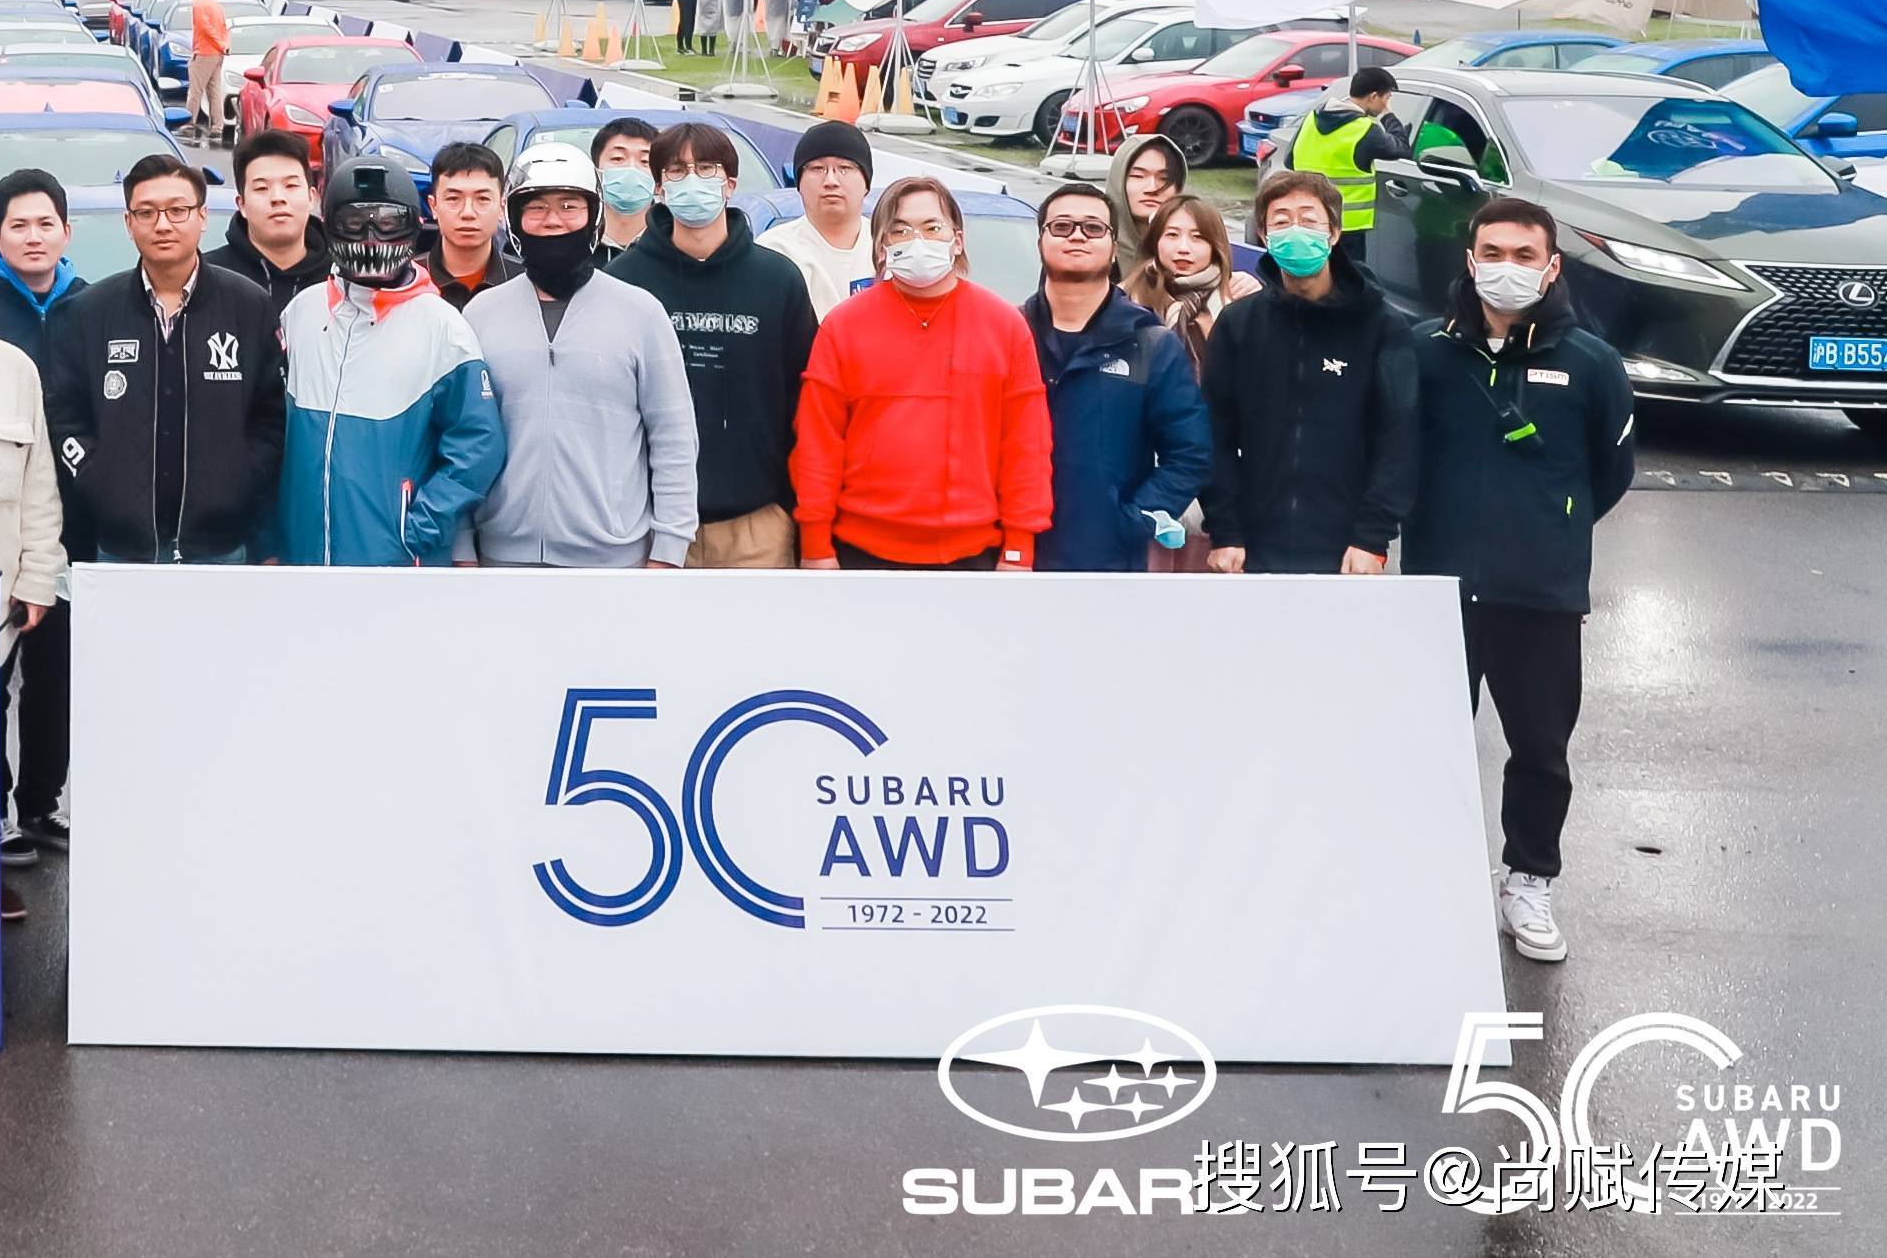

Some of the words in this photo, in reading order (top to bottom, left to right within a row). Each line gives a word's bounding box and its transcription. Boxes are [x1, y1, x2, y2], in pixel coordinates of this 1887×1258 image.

[815, 776, 1005, 806] SUBARU
[819, 815, 1011, 878] AWD
[848, 904, 904, 924] 1972
[930, 904, 988, 925] 2022
